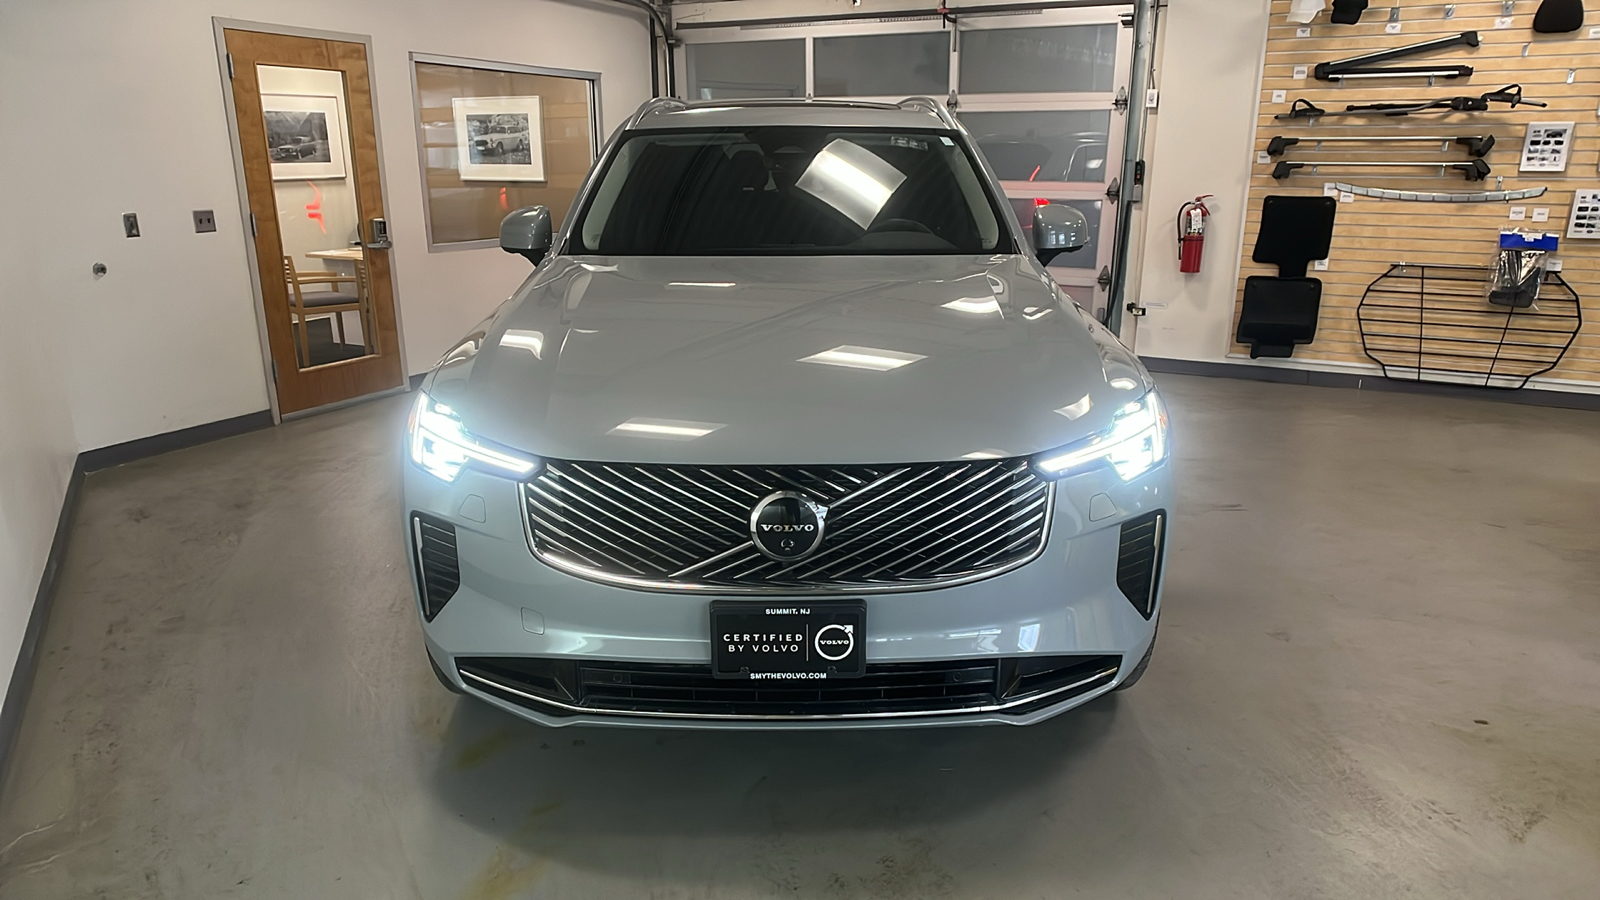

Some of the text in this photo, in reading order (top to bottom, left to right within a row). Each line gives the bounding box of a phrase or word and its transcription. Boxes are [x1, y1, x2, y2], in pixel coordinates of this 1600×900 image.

[760, 524, 815, 532] VOLVO
[723, 633, 803, 642] CERTIFIED
[728, 644, 799, 652] BY VOLVO
[750, 672, 827, 680] SMYTHEVOLVO.COM
